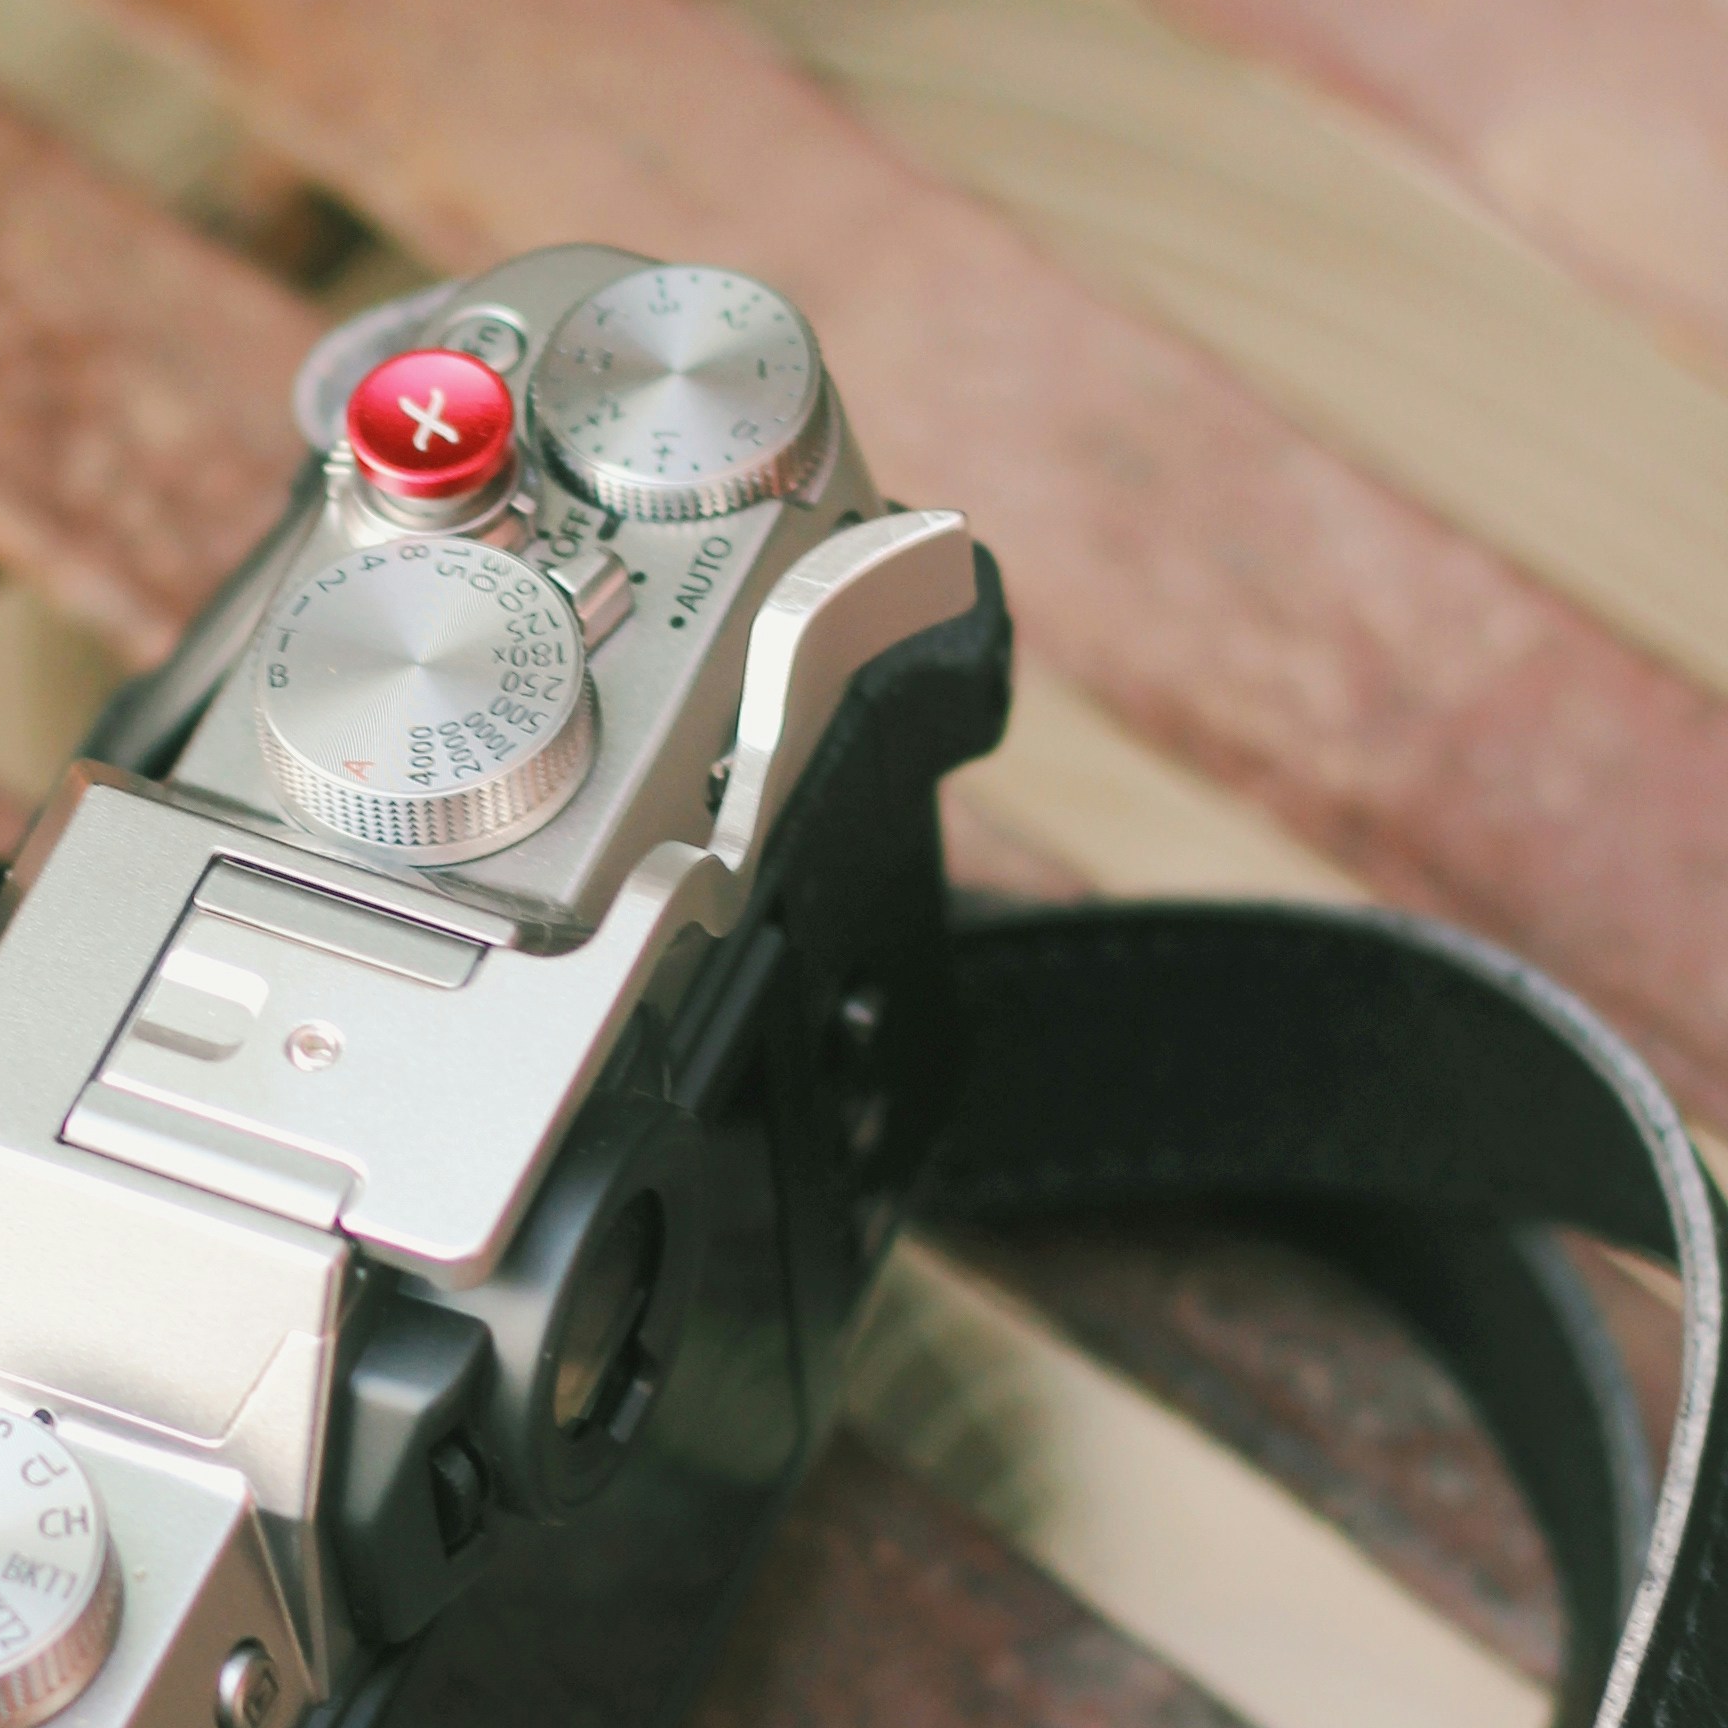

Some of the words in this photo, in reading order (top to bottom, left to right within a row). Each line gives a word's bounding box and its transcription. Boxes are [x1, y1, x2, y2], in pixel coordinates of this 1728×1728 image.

[548, 507, 595, 560] OFF
[359, 553, 387, 572] 4
[399, 544, 430, 561] 8
[315, 569, 348, 593] 2
[675, 536, 734, 615] AUTO
[276, 626, 299, 653] T
[505, 607, 563, 644] 125
[267, 662, 290, 690] B
[500, 671, 564, 702] 250
[488, 695, 550, 736] 500
[438, 721, 484, 780] 2000
[463, 712, 519, 762] 1000
[344, 760, 374, 782] A
[407, 725, 438, 787] 4000
[21, 1453, 70, 1487] CL
[38, 1505, 90, 1538] CH
